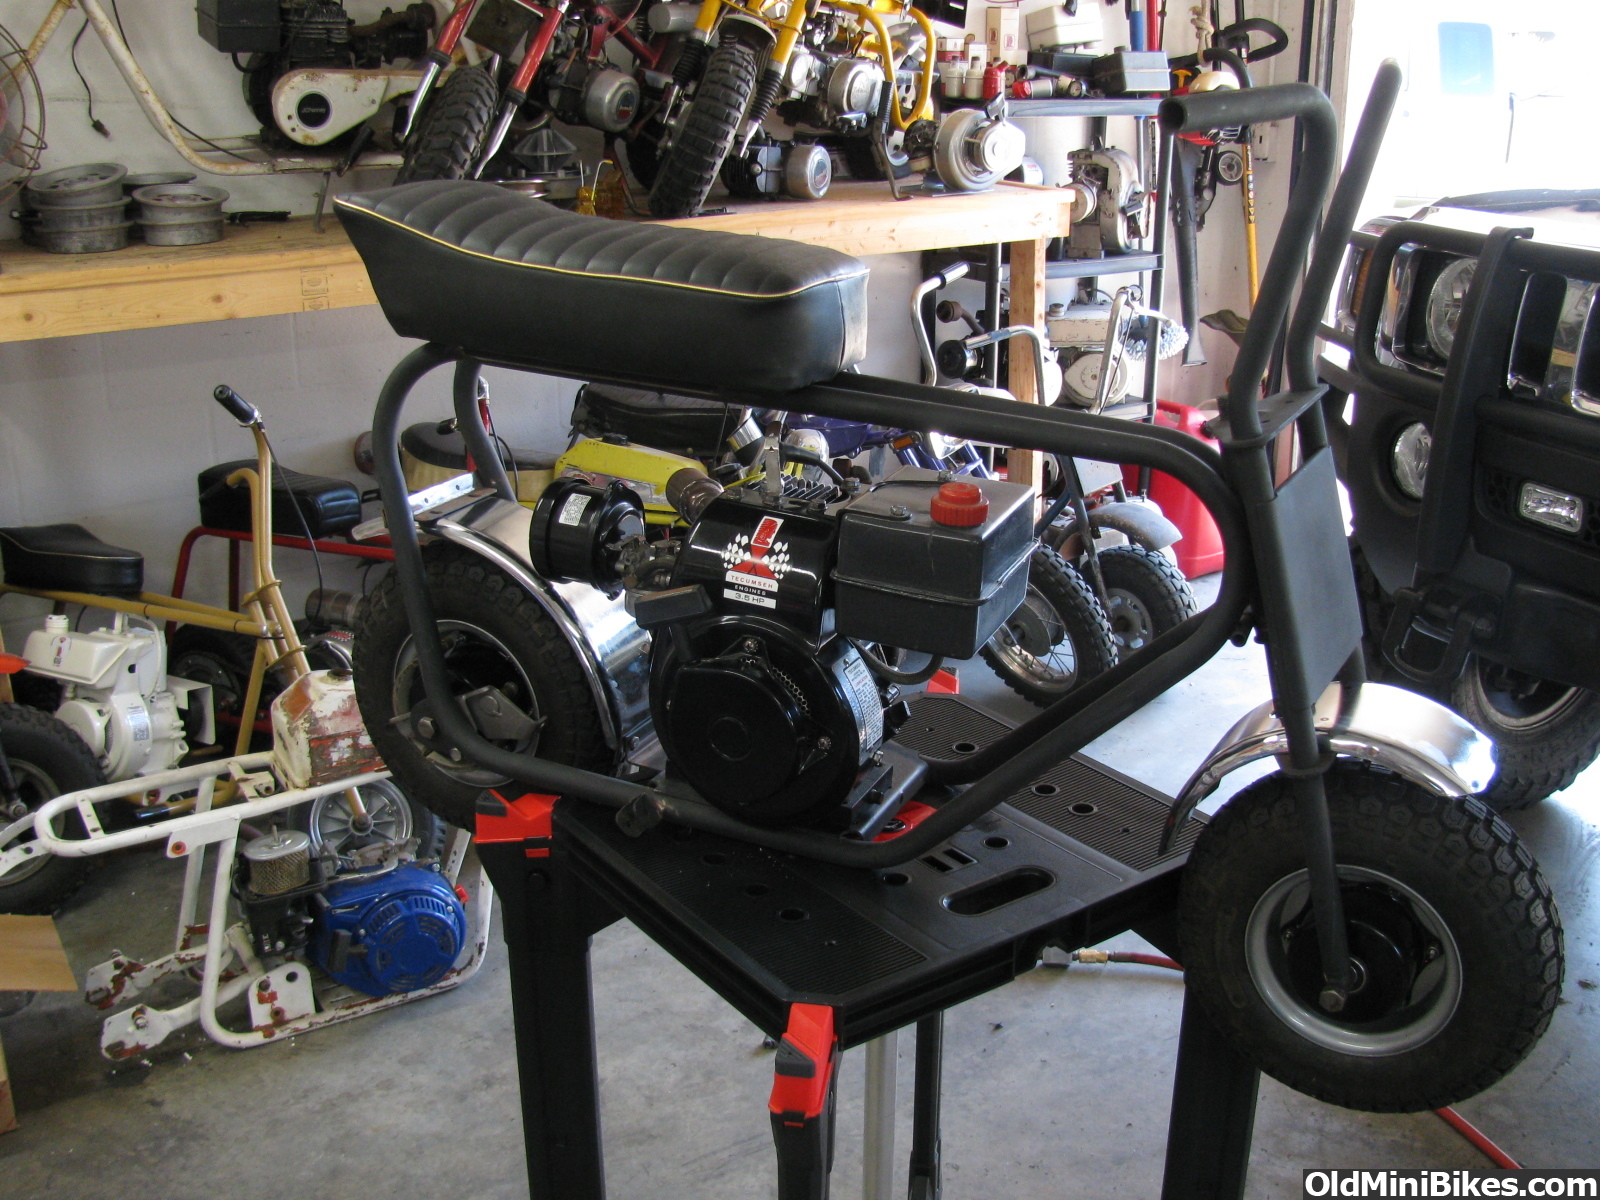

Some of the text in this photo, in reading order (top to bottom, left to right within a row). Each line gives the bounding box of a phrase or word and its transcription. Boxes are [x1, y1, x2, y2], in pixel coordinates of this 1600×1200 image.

[730, 575, 773, 589] TECUMSEH
[734, 585, 766, 595] ENGINES
[735, 592, 750, 601] 3.5
